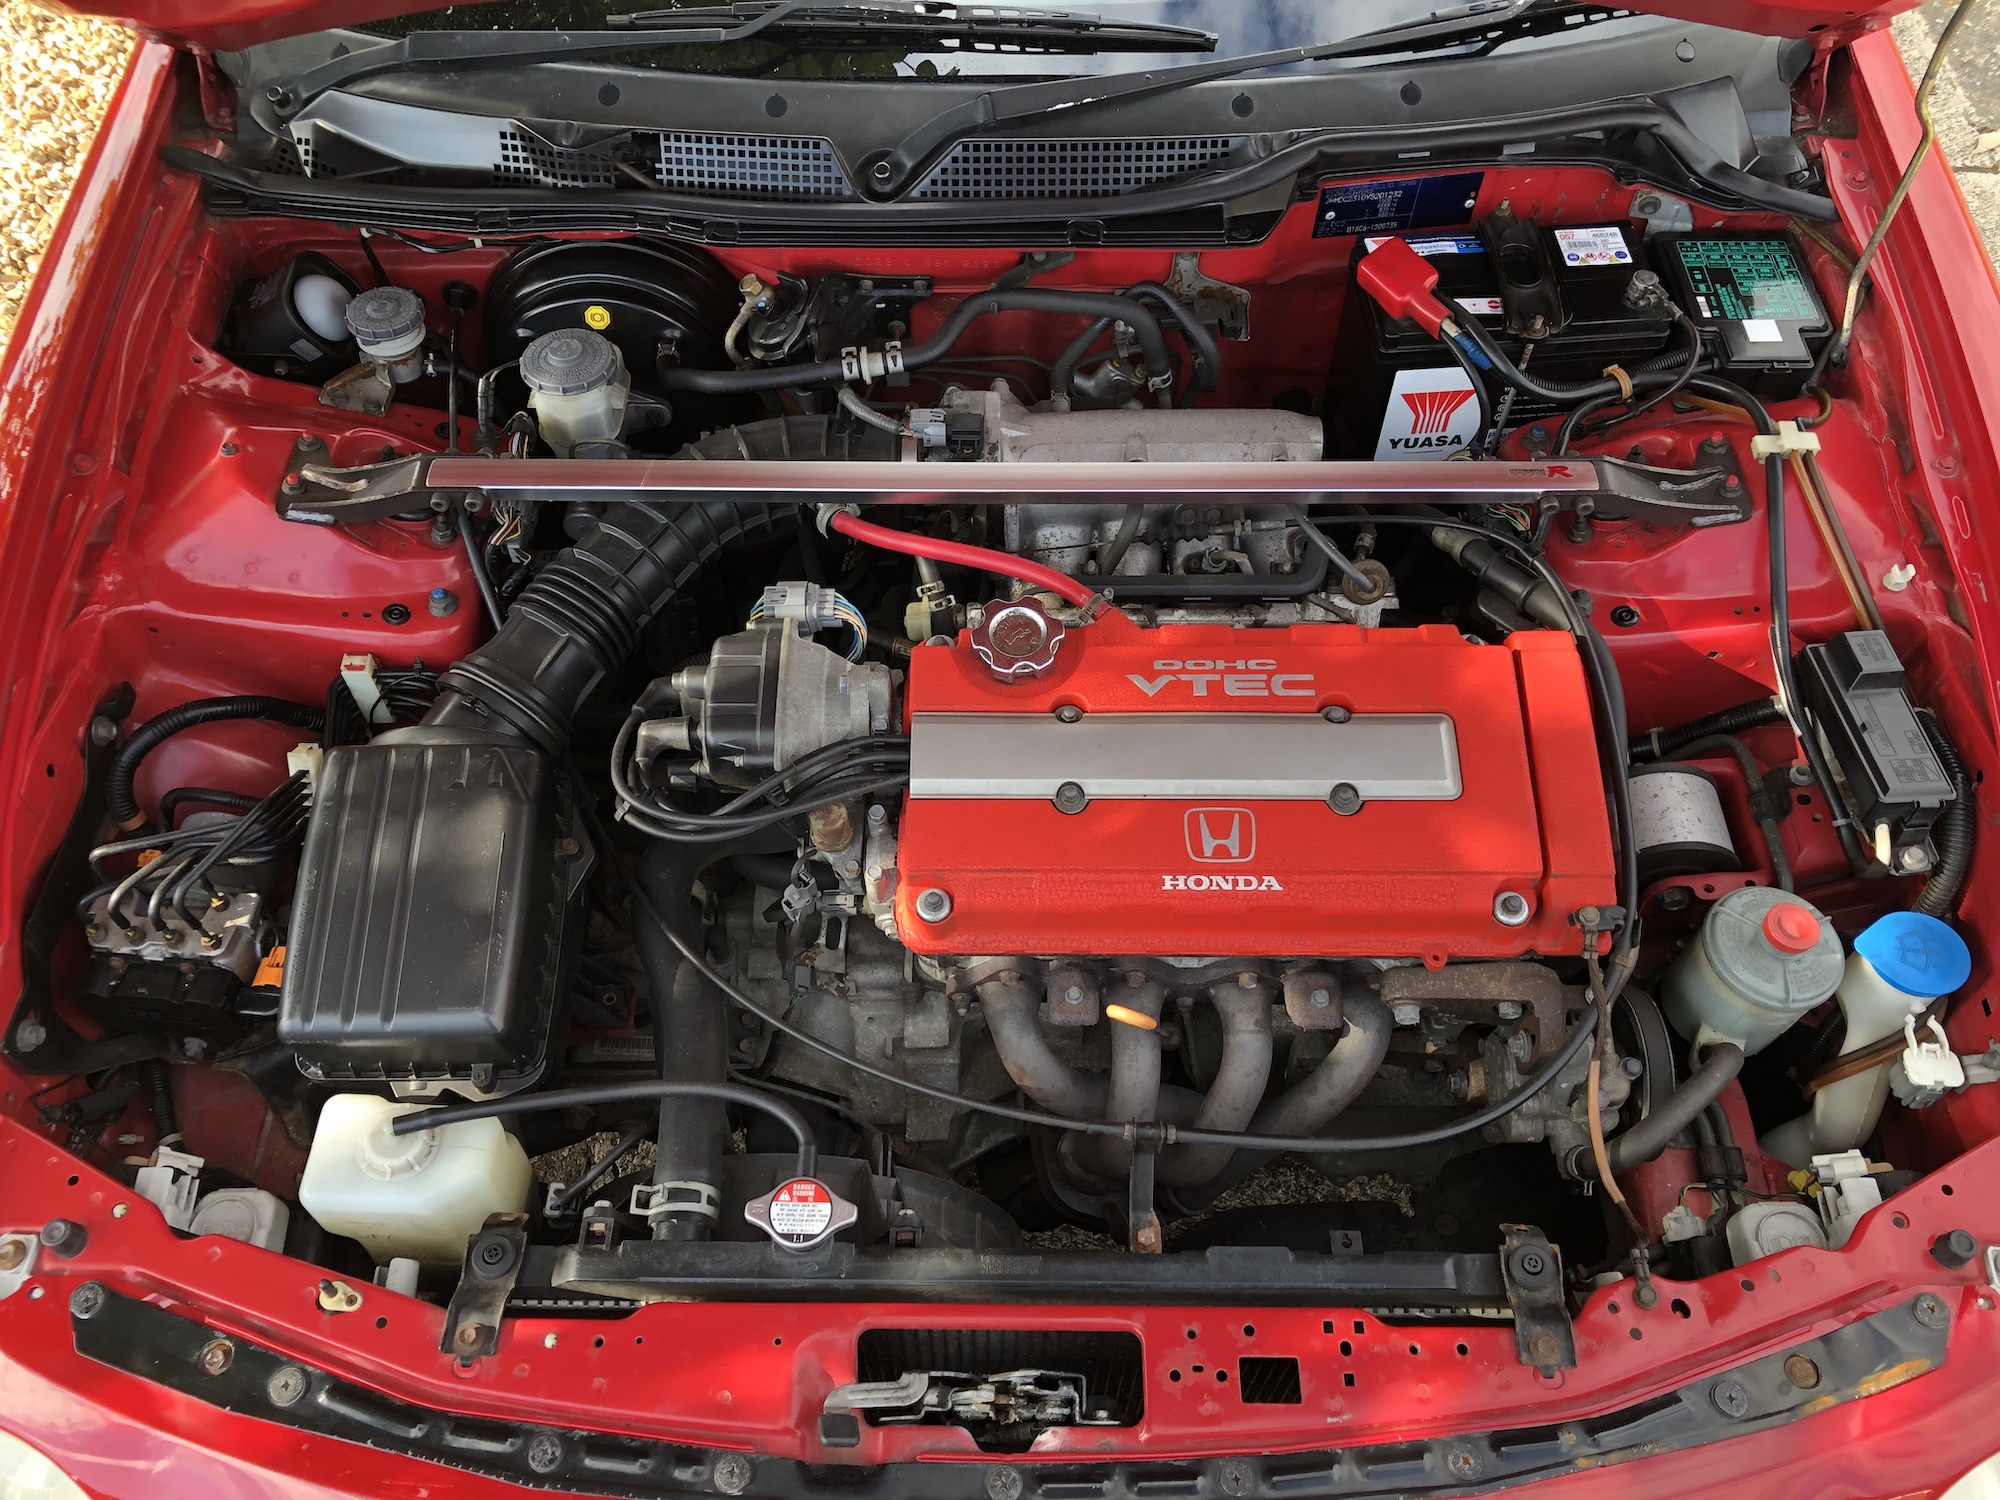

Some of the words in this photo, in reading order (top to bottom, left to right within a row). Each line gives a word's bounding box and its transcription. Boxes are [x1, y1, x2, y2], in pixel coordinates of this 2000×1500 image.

[1411, 243, 1456, 251] rofessional
[1389, 434, 1463, 449] YUASA
[1546, 465, 1574, 478] R
[1153, 659, 1278, 670] DOHC
[1125, 673, 1316, 698] VTEC
[1162, 875, 1284, 891] HONDA
[793, 1234, 804, 1243] 1.1
